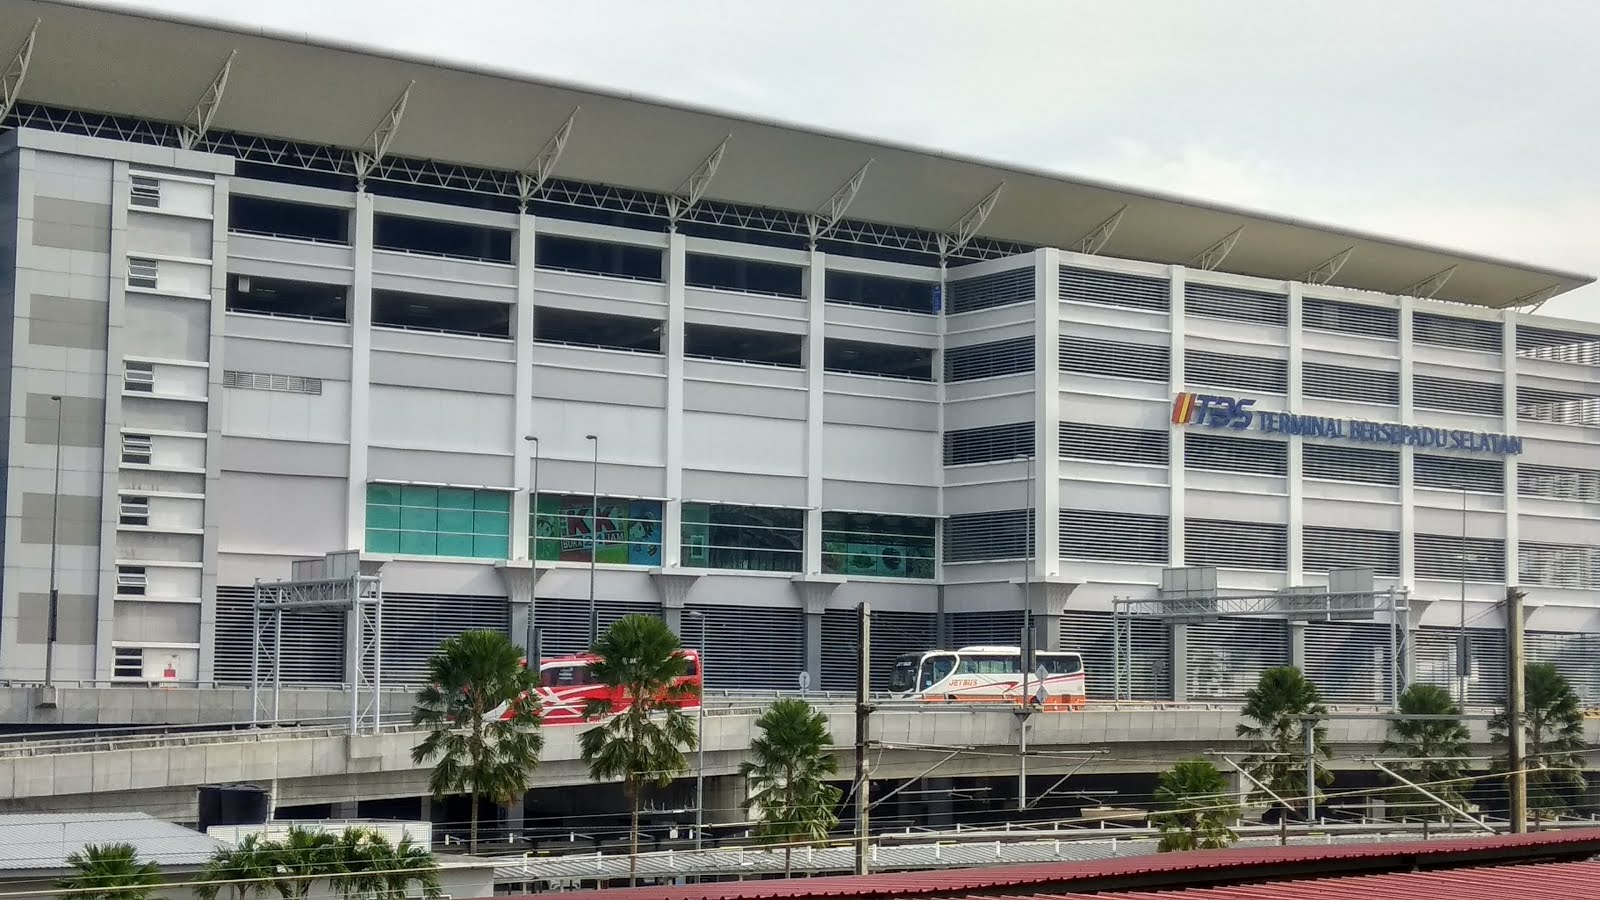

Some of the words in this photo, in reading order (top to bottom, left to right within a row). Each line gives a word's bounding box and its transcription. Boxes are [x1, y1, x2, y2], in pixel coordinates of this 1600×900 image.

[1196, 393, 1257, 429] TBS
[1259, 411, 1346, 438] TERMINAL
[1349, 419, 1449, 448] BERSEPADU
[1449, 429, 1523, 455] SELATAN
[567, 506, 616, 535] KK
